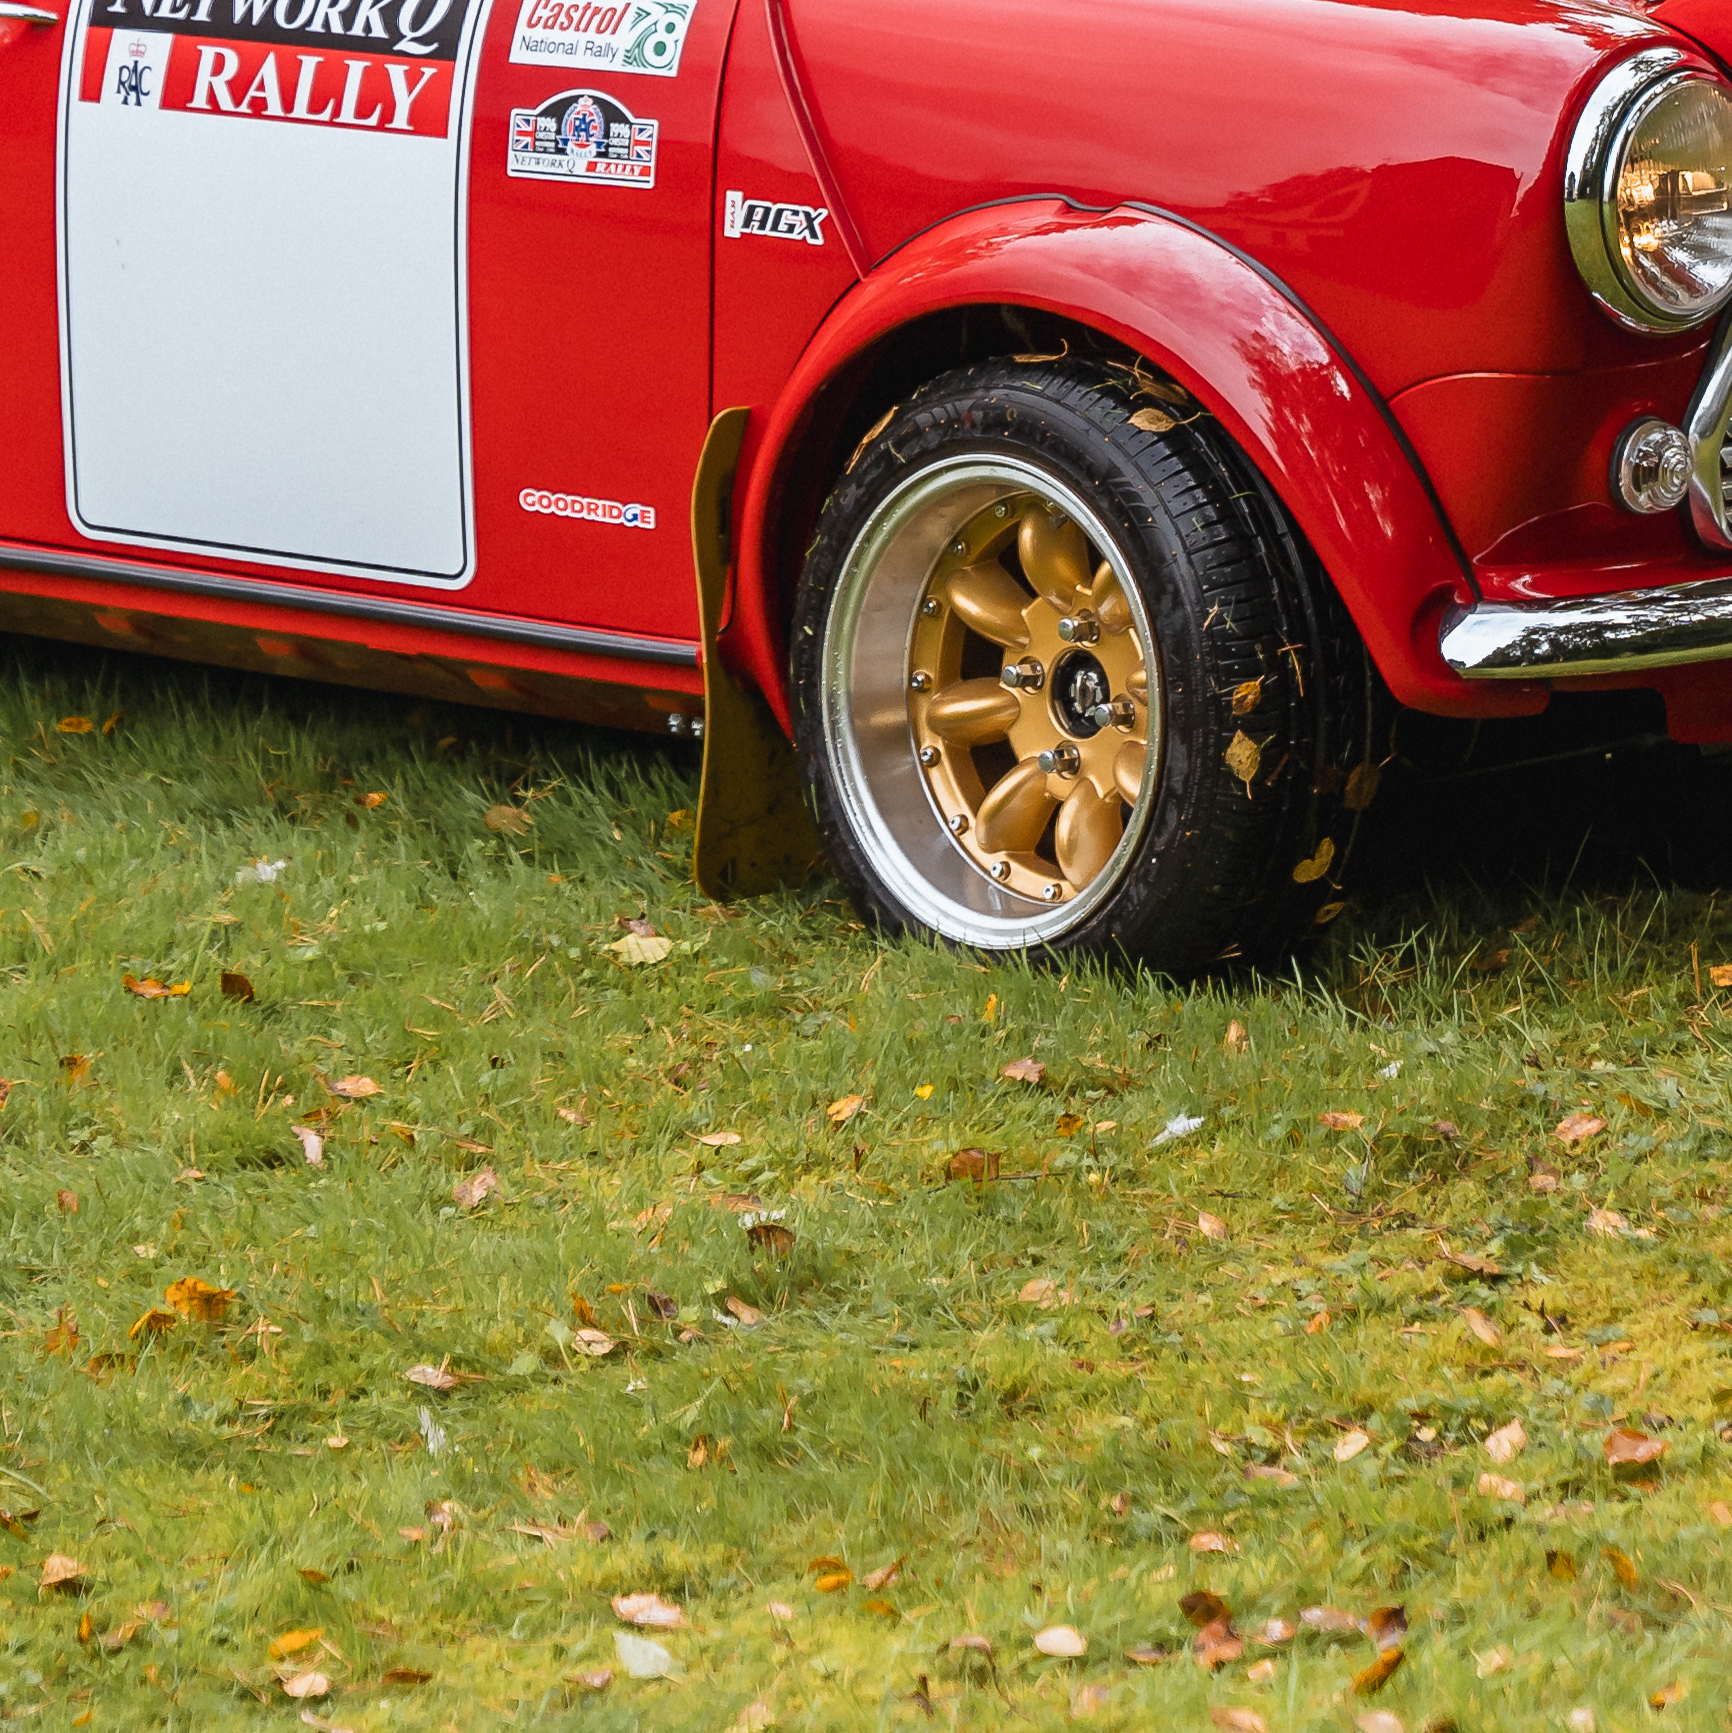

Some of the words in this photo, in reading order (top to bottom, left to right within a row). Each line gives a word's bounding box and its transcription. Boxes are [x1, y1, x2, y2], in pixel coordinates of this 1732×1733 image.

[519, 35, 579, 56] National
[583, 40, 619, 64] Rally
[186, 44, 438, 130] RALLY
[594, 162, 644, 177] RALLY
[741, 204, 824, 240] AGX
[523, 491, 652, 525] GOODRIDGE
